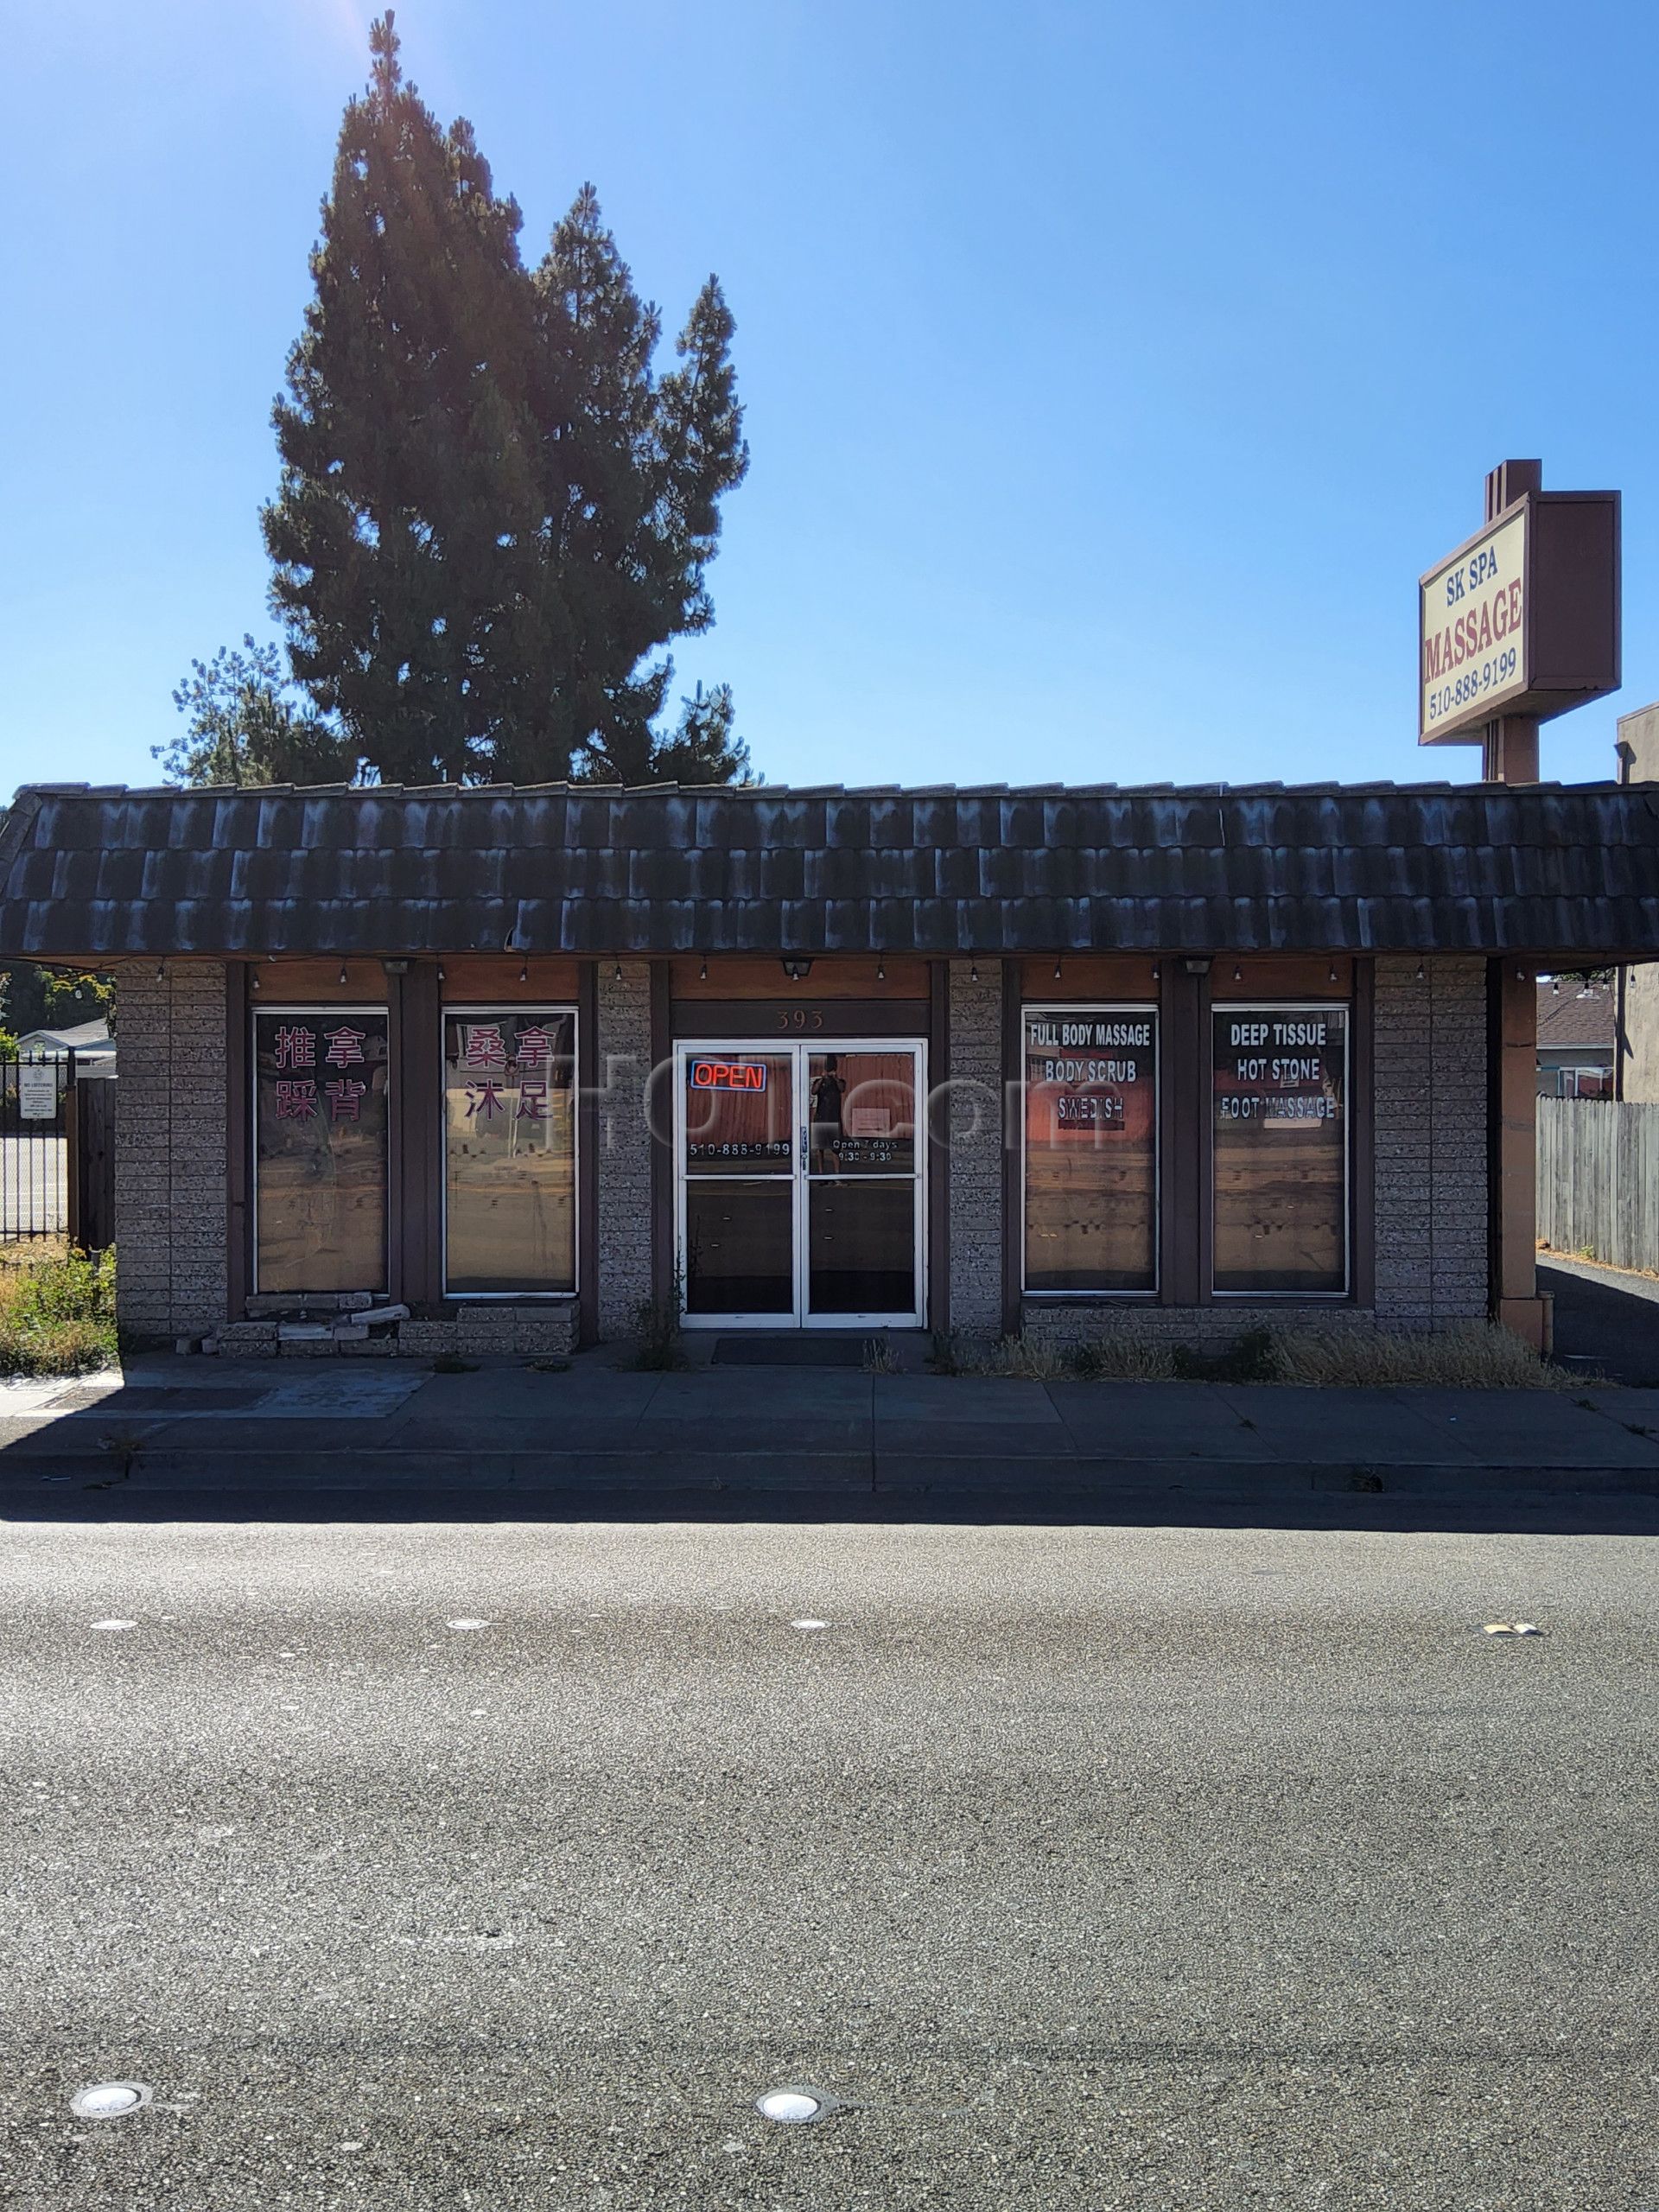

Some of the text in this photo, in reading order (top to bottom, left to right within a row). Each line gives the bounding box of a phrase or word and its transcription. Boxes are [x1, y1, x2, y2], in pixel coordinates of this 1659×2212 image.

[1446, 545, 1498, 607] SK SPA
[1425, 577, 1522, 684] MASSAGE
[1429, 647, 1516, 720] 510-888-9199
[777, 1009, 823, 1029] 393
[466, 1025, 556, 1068] 桑拿
[1031, 1023, 1150, 1046] FULL BODY MASSAGE
[1230, 1023, 1326, 1046] DEEP TISSUE
[275, 1026, 366, 1069] 推拿
[695, 1064, 762, 1089] OPEN
[1046, 1060, 1137, 1082] BODY SCRUB
[1237, 1058, 1320, 1081] HOT STONE
[275, 1078, 366, 1122] 踩背
[464, 1078, 554, 1122] 沐足
[1221, 1096, 1335, 1119] FOOT MASSAGE
[690, 1143, 791, 1156] 510-888-9199
[832, 1140, 860, 1151] Open
[873, 1140, 898, 1151] days
